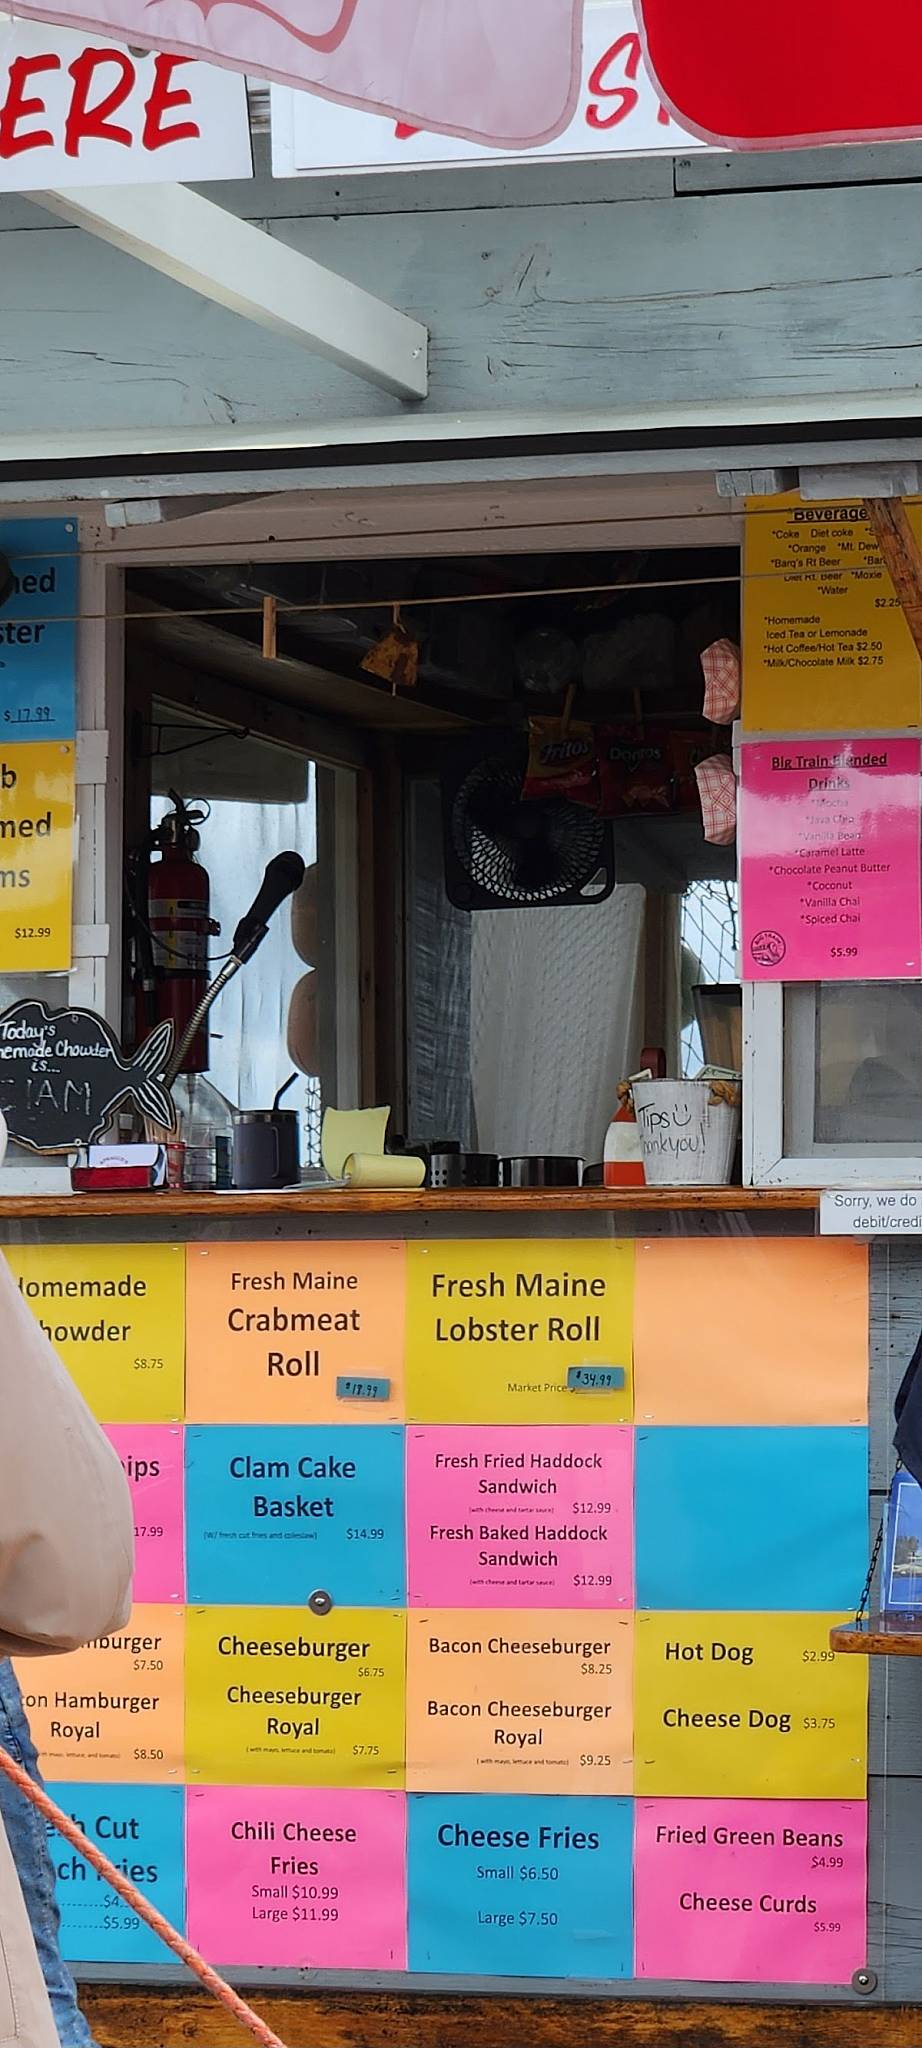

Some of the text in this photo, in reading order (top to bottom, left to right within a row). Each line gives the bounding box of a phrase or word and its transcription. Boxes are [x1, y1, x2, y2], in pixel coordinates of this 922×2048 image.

[811, 528, 829, 538] Diet
[831, 528, 853, 537] coke
[819, 557, 841, 566] Beer
[875, 598, 901, 608] $2.25
[766, 629, 786, 640] Iced
[789, 629, 805, 639] Tea
[820, 628, 868, 638] Lemonade
[786, 643, 835, 654] Coffee/Hot
[838, 643, 853, 652] Tea
[857, 641, 883, 652] $2.50
[837, 656, 855, 666] Milk
[857, 656, 884, 666] $2.75
[772, 756, 791, 769] Big
[797, 755, 828, 768] Train
[809, 777, 850, 792] Drinks
[841, 847, 865, 857] Latte
[824, 864, 858, 874] Peanut
[860, 863, 891, 873] Butter
[839, 897, 861, 907] Chai
[839, 914, 861, 924] Chai
[15, 927, 51, 939] $12.99
[830, 947, 858, 958] $5.99
[0, 1020, 56, 1048] Today's
[55, 1039, 112, 1058] Chowder
[638, 1102, 670, 1134] Tips
[834, 1194, 916, 1209] Sorry, we do
[231, 1271, 358, 1290] Fresh Maine
[432, 1272, 606, 1297] Fresh Maine
[228, 1307, 360, 1332] Crabmeat
[436, 1316, 599, 1341] Lobster Roll
[134, 1359, 163, 1370] $8.75
[268, 1351, 320, 1376] Roll
[576, 1370, 612, 1386] $34.99
[507, 1383, 541, 1392] Market
[544, 1383, 567, 1392] Price
[230, 1455, 356, 1479] Clam Cake
[435, 1453, 602, 1469] Fresh Fried Haddock
[478, 1478, 557, 1494] Sandwich
[253, 1495, 335, 1518] Basket
[572, 1502, 611, 1514] $12.99
[346, 1528, 384, 1540] $14.99
[430, 1525, 608, 1541] Fresh Baked Haddock
[479, 1550, 558, 1566] Sandwich
[573, 1575, 612, 1587] $12.99
[218, 1636, 370, 1661] Cheeseburger
[429, 1638, 611, 1658] Bacon Cheeseburger
[665, 1642, 754, 1665] Hot Dog
[802, 1650, 835, 1663] $2.99
[134, 1660, 163, 1671] $7.50
[358, 1667, 384, 1677] $6.75
[581, 1663, 612, 1675] $8.25
[22, 1692, 159, 1713] on Hamburger
[227, 1686, 362, 1709] Cheeseburger
[427, 1701, 612, 1721] Bacon Cheeseburger
[663, 1709, 791, 1732] Cheese Dog
[803, 1718, 835, 1730] $3.75
[51, 1721, 100, 1742] Royal
[267, 1718, 319, 1740] Royal
[494, 1729, 542, 1748] Royal
[134, 1749, 163, 1760] $8.50
[352, 1745, 379, 1756] $7.75
[580, 1755, 611, 1766] $9.25
[95, 1815, 140, 1840] Cut
[231, 1821, 357, 1842] Chili Cheese
[438, 1823, 599, 1849] Cheese Fries
[656, 1826, 844, 1847] Fried Green Beans
[271, 1856, 319, 1875] Fries
[812, 1856, 844, 1868] $4.99
[477, 1866, 559, 1880] Small $6.50
[252, 1885, 339, 1899] Small $10.99
[679, 1892, 817, 1913] Cheese Curds
[252, 1906, 339, 1922] Large $11.99
[478, 1911, 557, 1927] Large $7.50
[813, 1922, 841, 1932] $5.99
